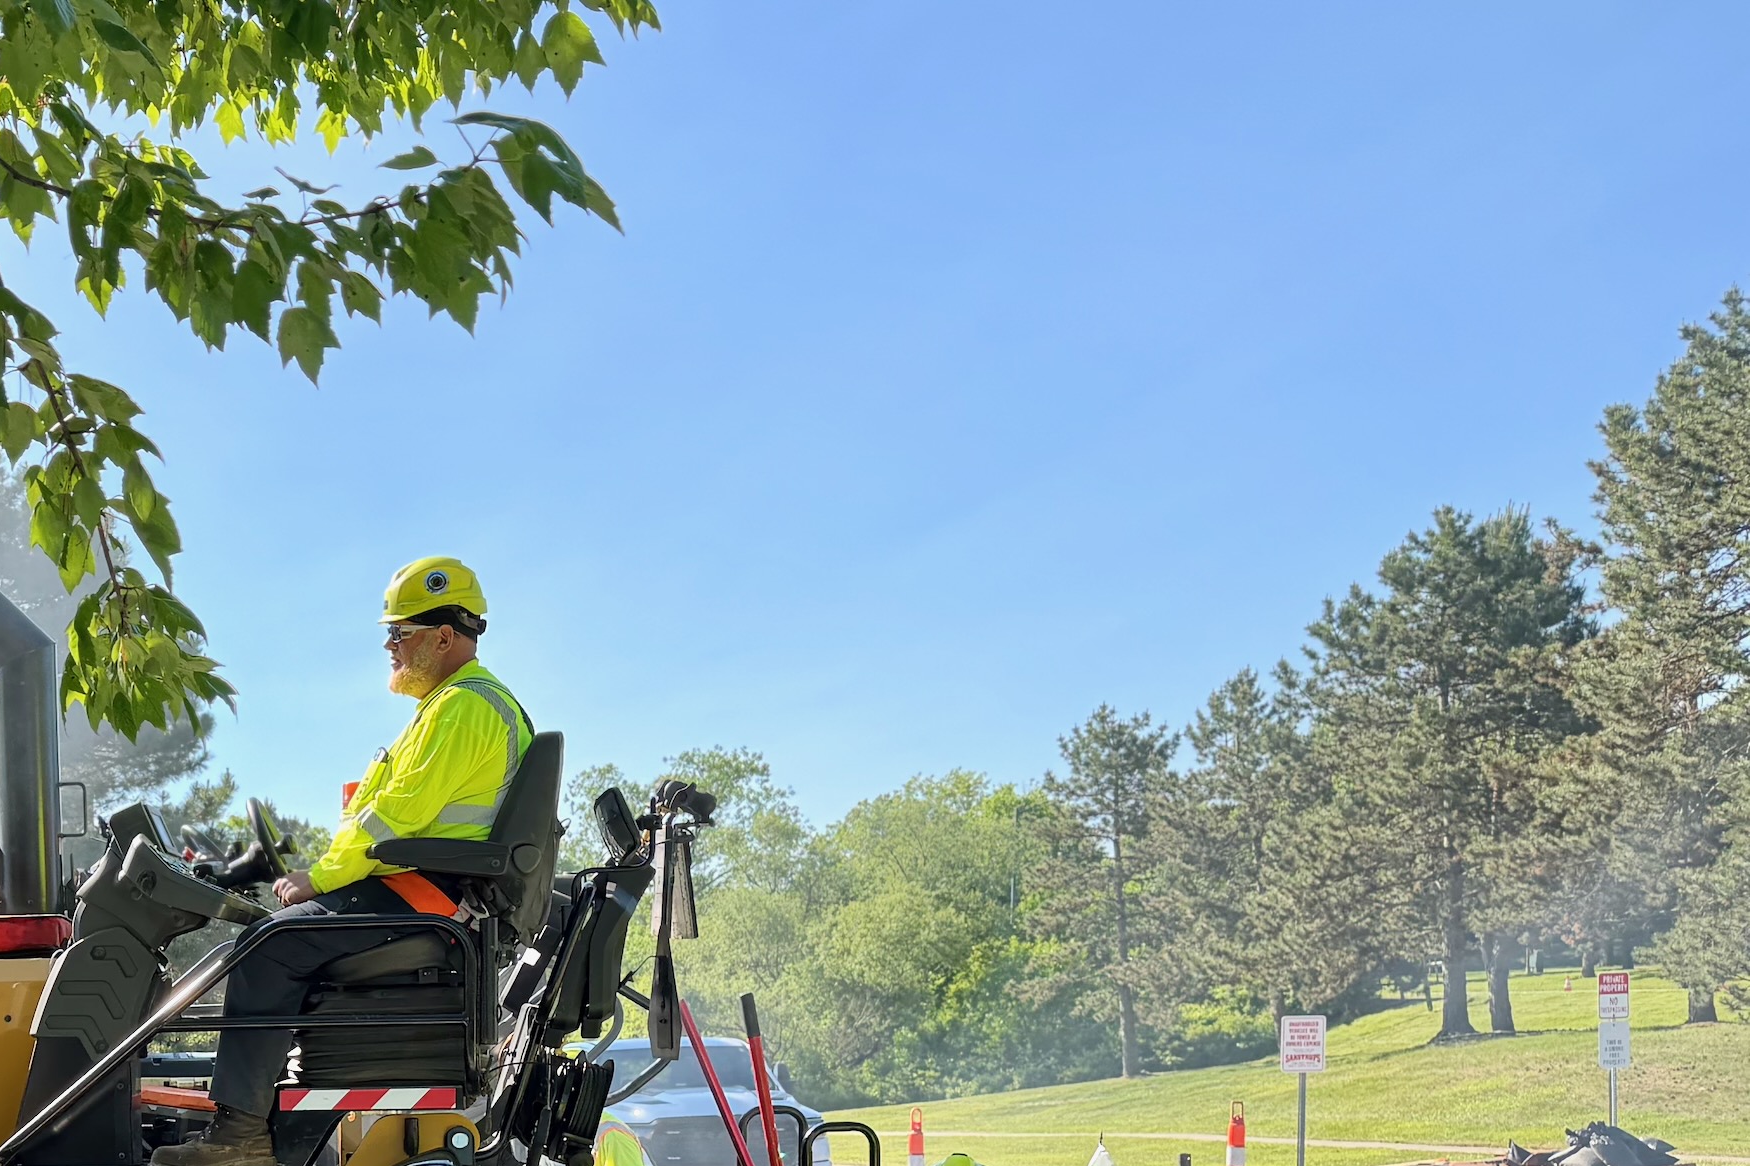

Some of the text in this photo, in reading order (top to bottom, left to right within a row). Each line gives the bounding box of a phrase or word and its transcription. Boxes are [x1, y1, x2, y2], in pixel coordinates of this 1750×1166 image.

[1603, 975, 1624, 983] PRIVATE
[1600, 984, 1627, 992] PROPERTY
[1610, 997, 1618, 1005] NO
